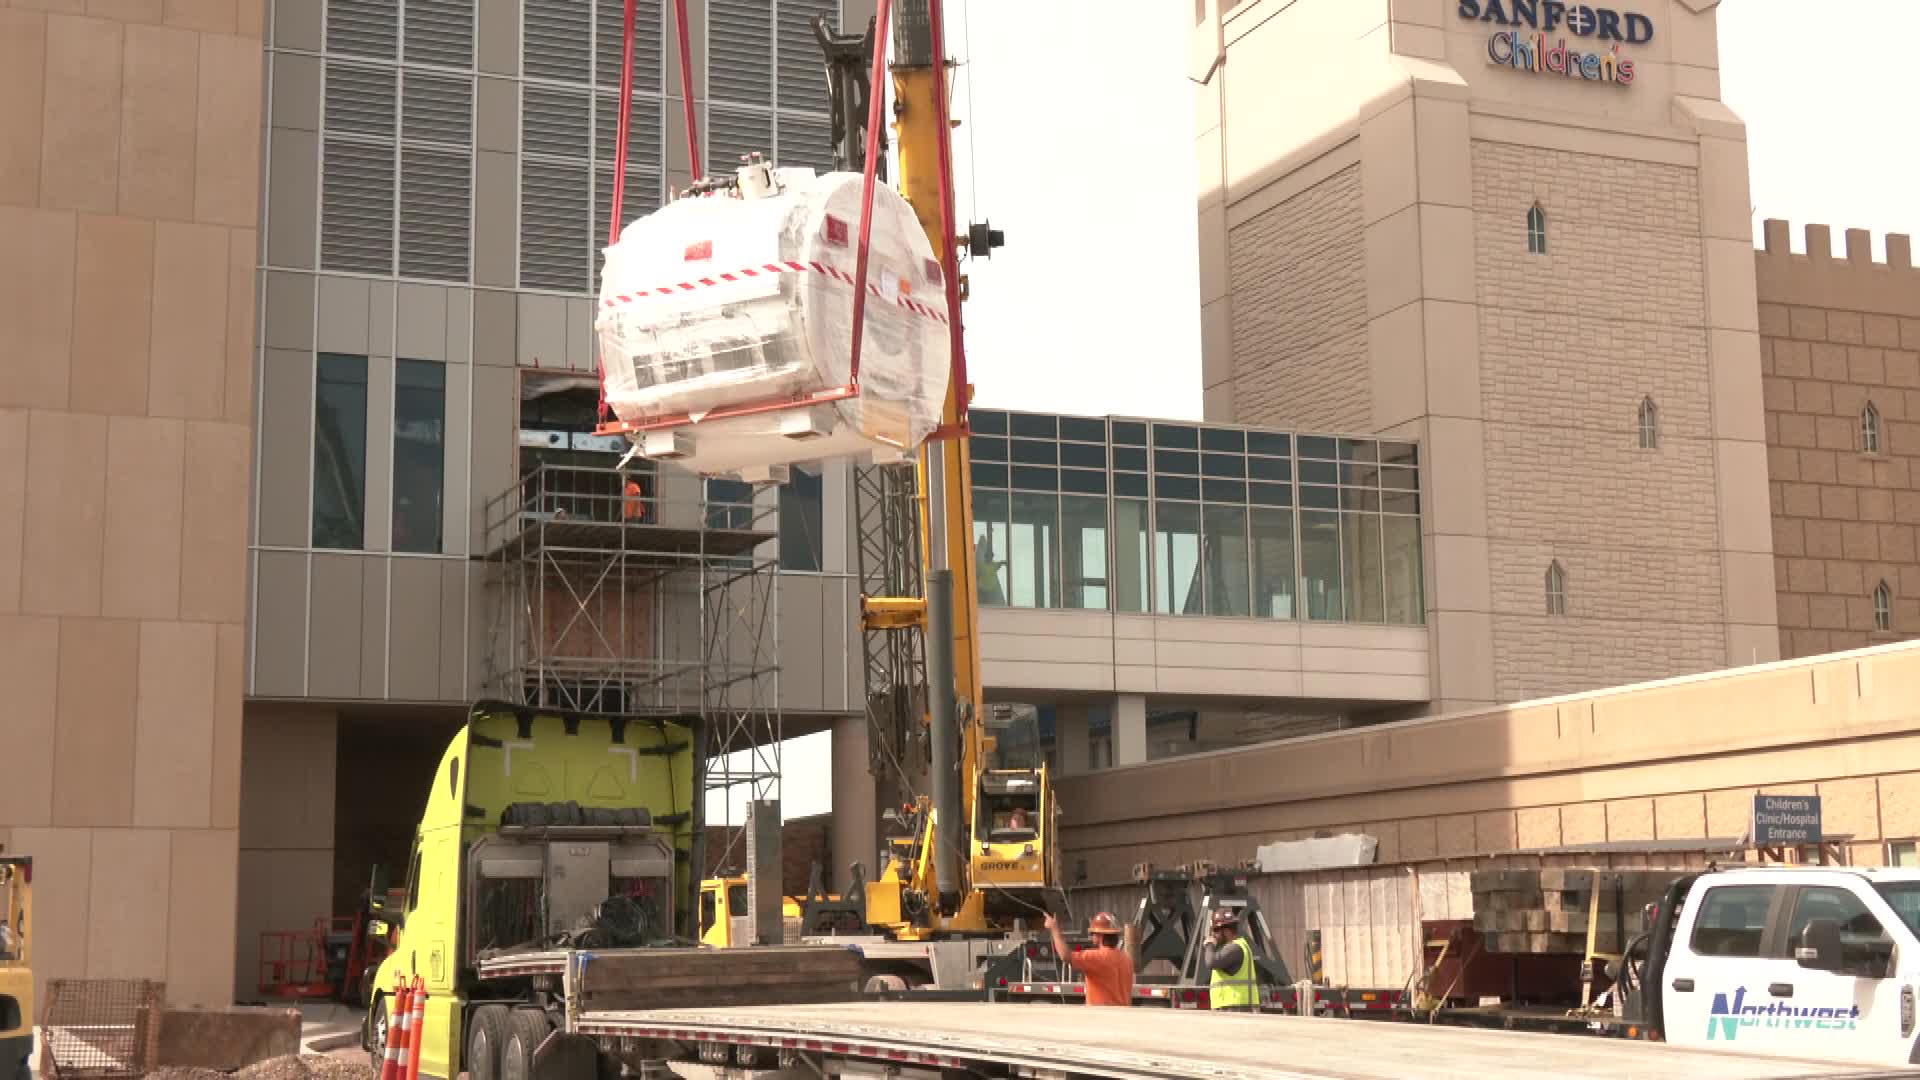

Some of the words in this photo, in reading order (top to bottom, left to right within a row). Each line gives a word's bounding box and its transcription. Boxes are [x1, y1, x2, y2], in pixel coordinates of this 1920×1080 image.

[1458, 0, 1654, 44] SANFORD
[1488, 31, 1635, 84] Children's
[1765, 798, 1809, 810] Children's
[1756, 812, 1818, 826] Clinic/Hospital
[1767, 826, 1807, 839] Entrance
[980, 861, 1019, 871] GROVE
[1706, 985, 1860, 1040] Northwest
